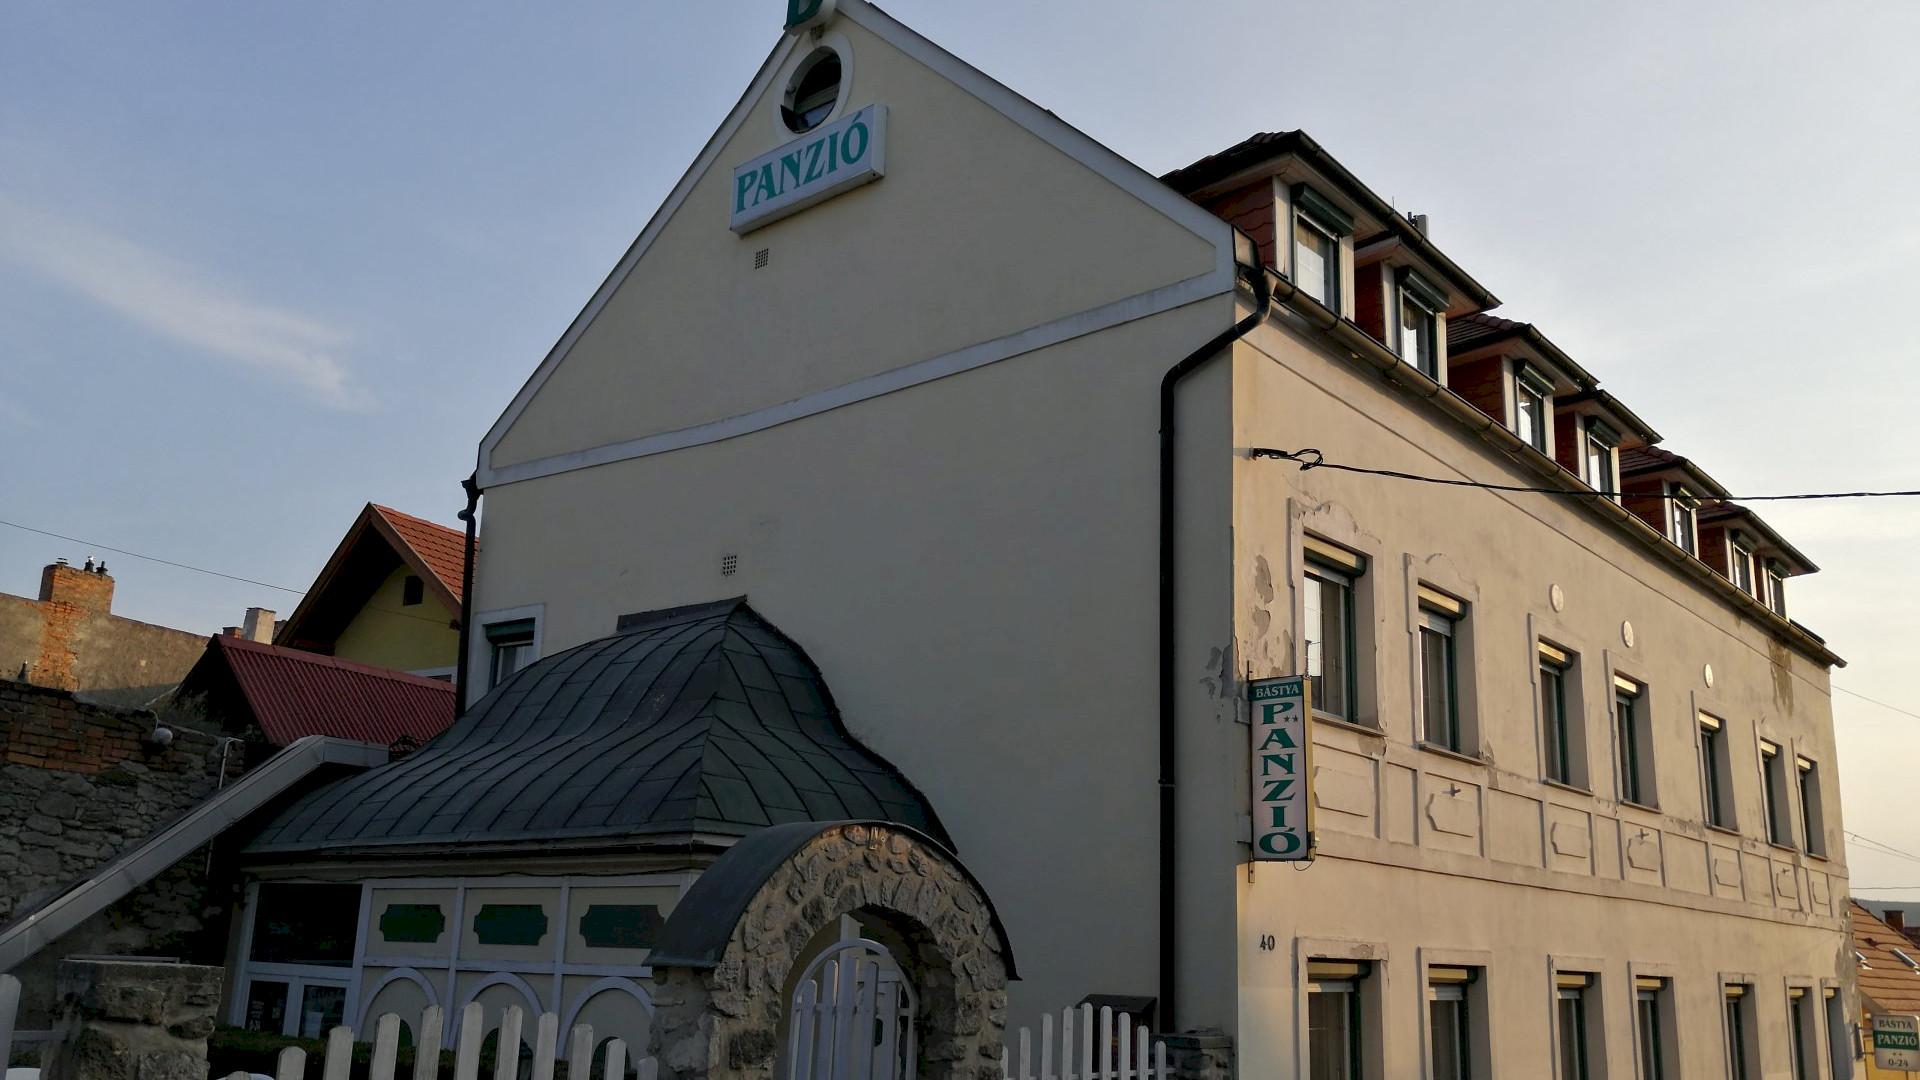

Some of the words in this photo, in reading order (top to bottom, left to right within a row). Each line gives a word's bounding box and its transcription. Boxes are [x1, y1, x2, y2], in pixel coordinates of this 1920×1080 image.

[735, 111, 869, 214] PANZIÓ
[1255, 683, 1300, 698] BÁSTYA
[1257, 701, 1301, 855] PANZIÓ
[1260, 934, 1275, 951] 40
[1877, 1033, 1918, 1046] PANZIÓ
[1888, 1058, 1909, 1067] 0-24
